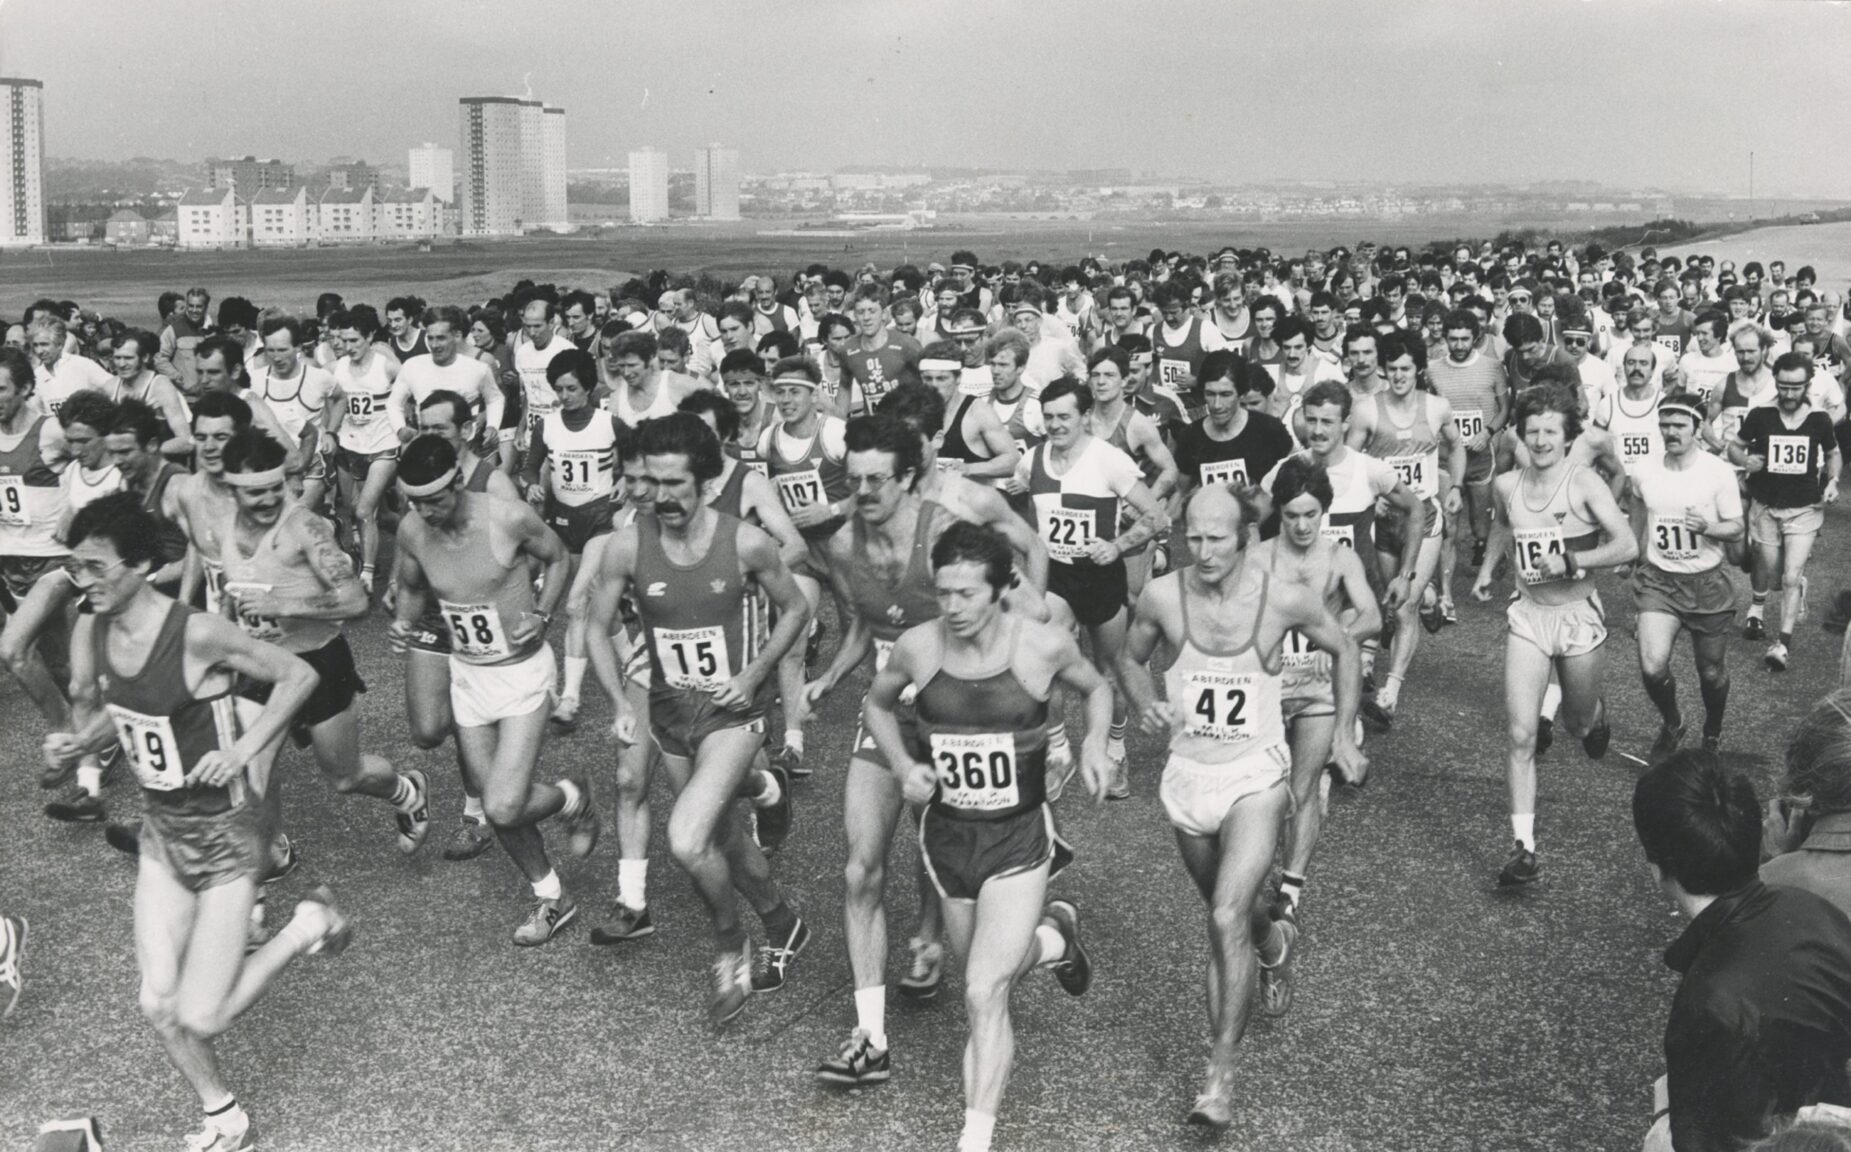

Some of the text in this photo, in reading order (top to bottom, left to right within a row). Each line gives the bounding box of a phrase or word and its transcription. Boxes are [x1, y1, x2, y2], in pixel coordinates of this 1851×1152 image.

[1623, 437, 1649, 455] 559
[1773, 443, 1807, 464] 136
[561, 460, 589, 483] 31
[782, 481, 819, 508] 107
[1049, 517, 1089, 546] 221
[1656, 525, 1697, 551] 311
[450, 614, 495, 645] 58
[661, 629, 718, 641] ABERDEEN
[671, 640, 718, 678] 15
[1191, 675, 1252, 686] ABERDEEN
[1194, 687, 1247, 727] 42
[937, 750, 1012, 790] 360
